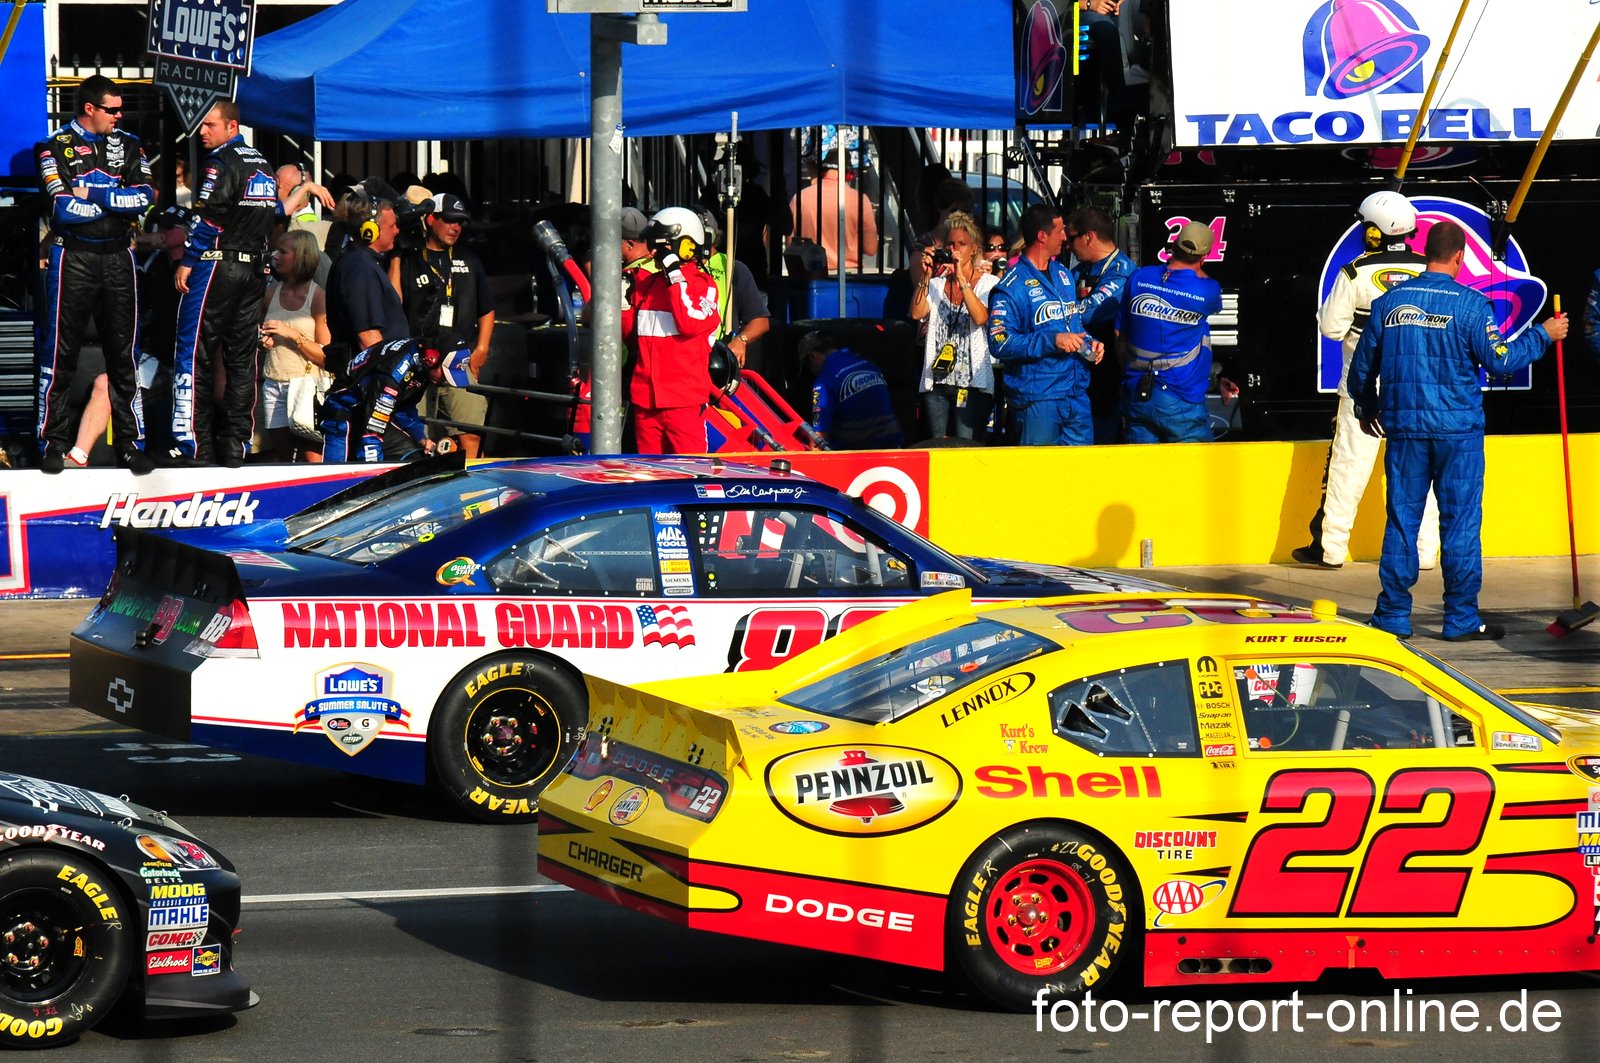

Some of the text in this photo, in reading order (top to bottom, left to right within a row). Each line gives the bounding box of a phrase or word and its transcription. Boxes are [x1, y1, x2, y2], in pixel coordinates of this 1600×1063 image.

[162, 0, 237, 51] LOWE'S
[160, 62, 228, 86] RACING
[1185, 107, 1544, 145] TACO BELL
[100, 491, 259, 529] Hendrick
[657, 526, 686, 541] MAC
[450, 563, 481, 572] QUAKER
[200, 612, 232, 643] 88
[281, 602, 634, 649] NATIONAL GUARD
[1245, 635, 1347, 643] KURT BUSCH
[329, 677, 379, 692] LOWE'S
[464, 662, 524, 699] EAGLE
[1199, 681, 1223, 697] PPG
[318, 700, 388, 712] SUMMER SALUTE
[941, 678, 1017, 728] LENNOX
[361, 718, 370, 728] G
[1000, 723, 1035, 738] Kurt's
[1200, 721, 1232, 729] Mazak
[1020, 741, 1049, 754] Krew
[613, 751, 674, 782] DODGE
[796, 759, 934, 804] PENNZOIL
[974, 765, 1162, 799] Shell
[690, 785, 722, 814] 22
[1134, 830, 1217, 848] DISCOUNT
[1226, 766, 1496, 918] 22
[568, 841, 644, 882] CHARGER
[1157, 849, 1193, 859] TIRE
[140, 866, 181, 878] Gatorback
[57, 865, 119, 921] EAGLE
[150, 883, 206, 899] MOOG
[152, 897, 205, 908] CHASSIS PARTS
[1156, 880, 1200, 914] AAA
[149, 905, 208, 926] MAHLE
[765, 893, 915, 932] DODGE
[963, 872, 988, 946] EAGLE
[1076, 843, 1127, 988] GOODYEAR
[148, 931, 194, 947] COMP
[149, 955, 189, 969] Edelbrock
